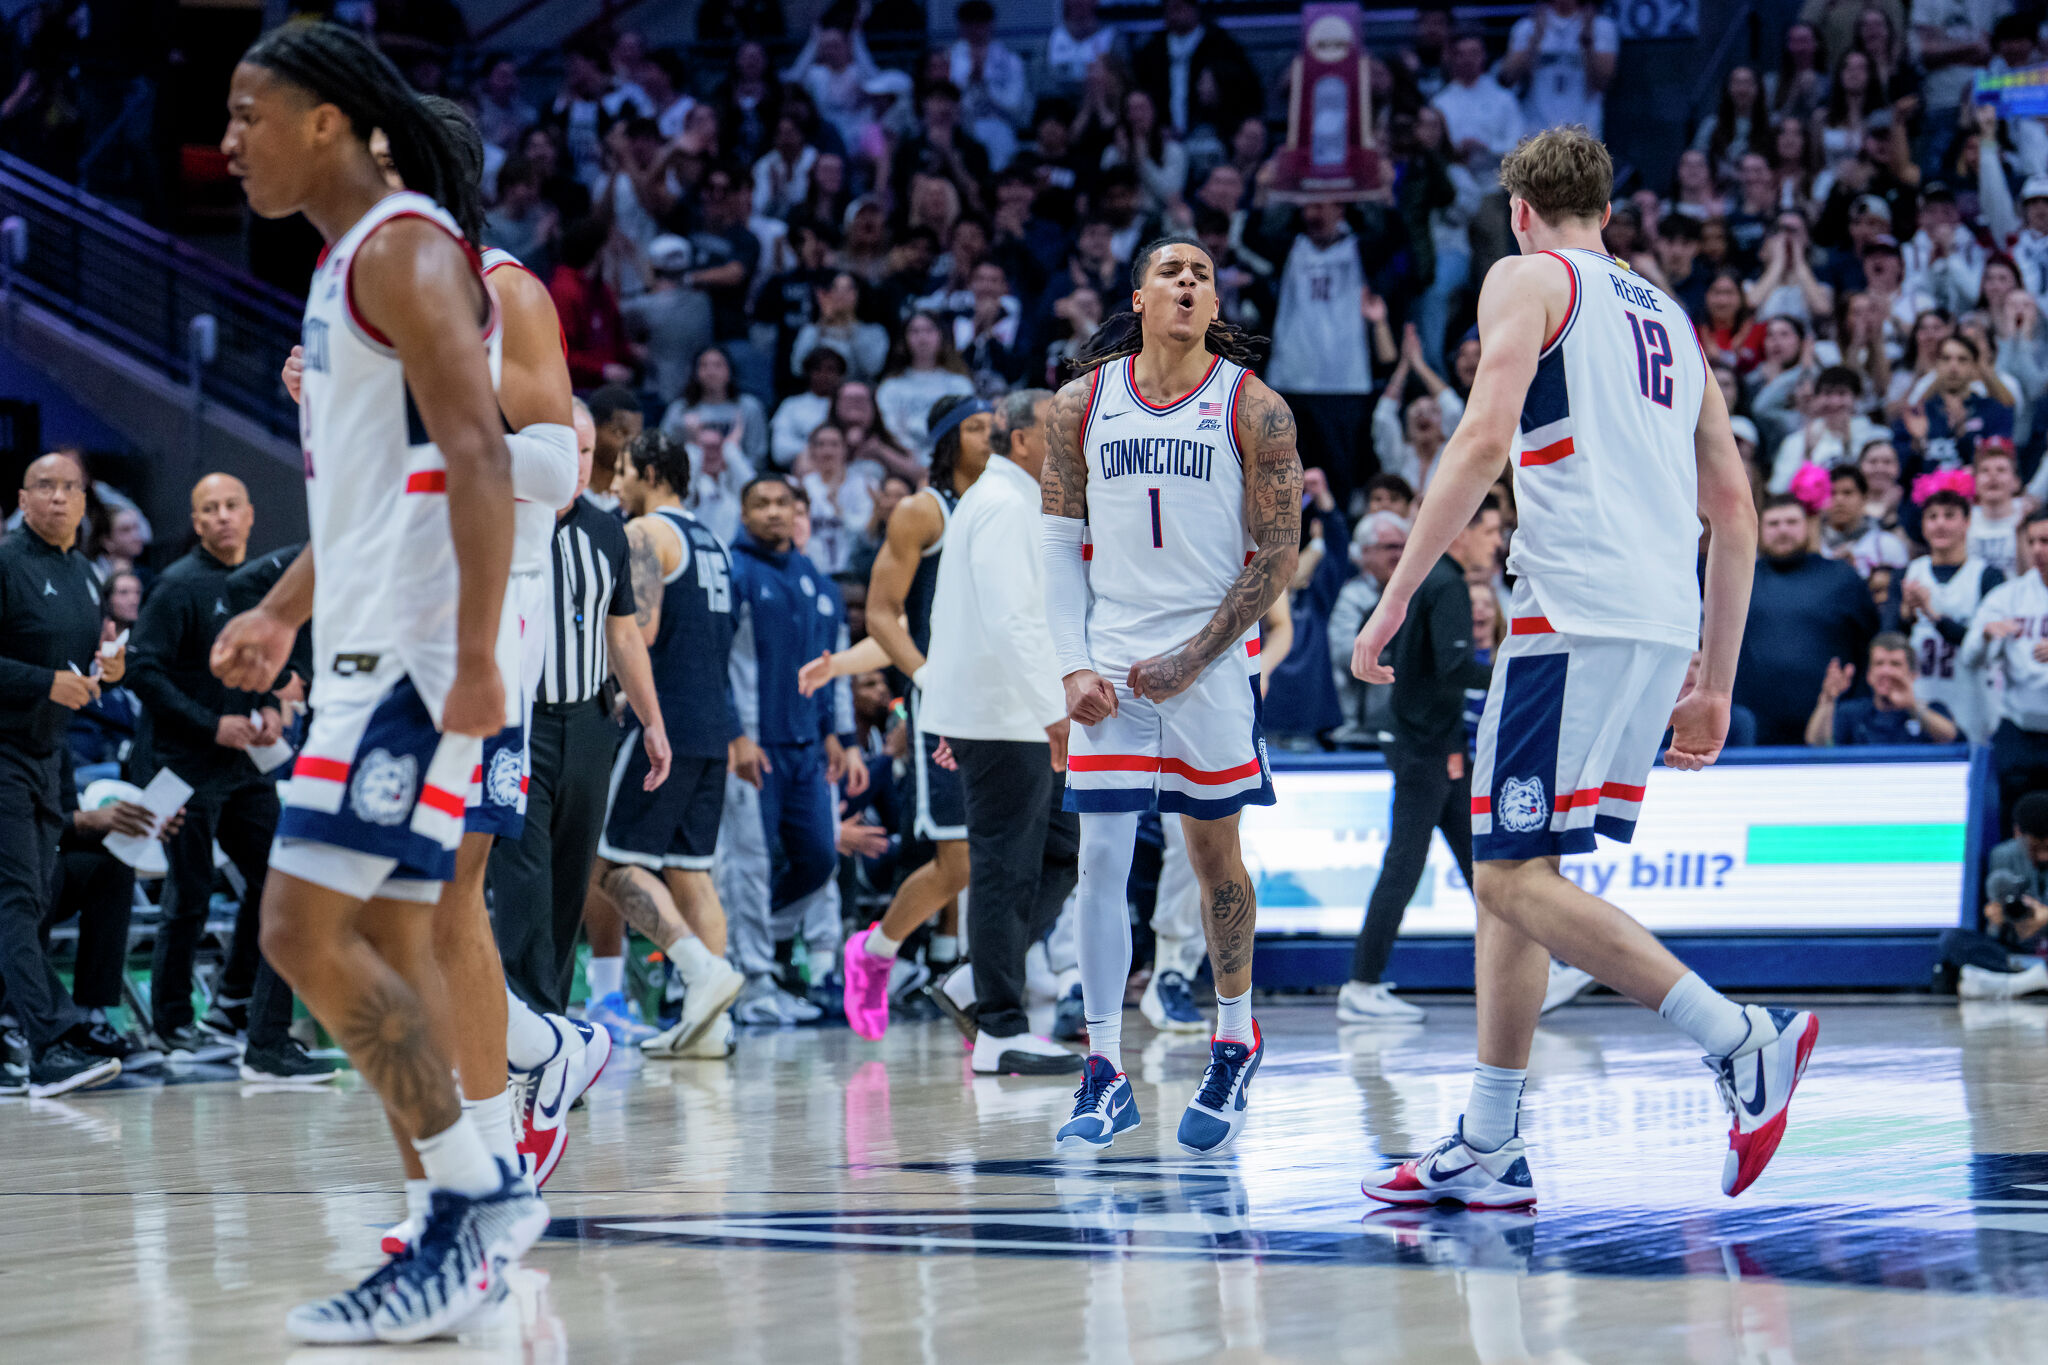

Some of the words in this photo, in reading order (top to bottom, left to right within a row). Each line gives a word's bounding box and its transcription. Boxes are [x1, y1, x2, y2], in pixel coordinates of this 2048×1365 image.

[1608, 273, 1662, 313] REIBE
[1624, 310, 1674, 410] 12
[1100, 438, 1216, 482] CONNECTICUT
[1148, 488, 1163, 549] 1
[694, 549, 732, 613] 45
[1630, 853, 1734, 888] bill?
